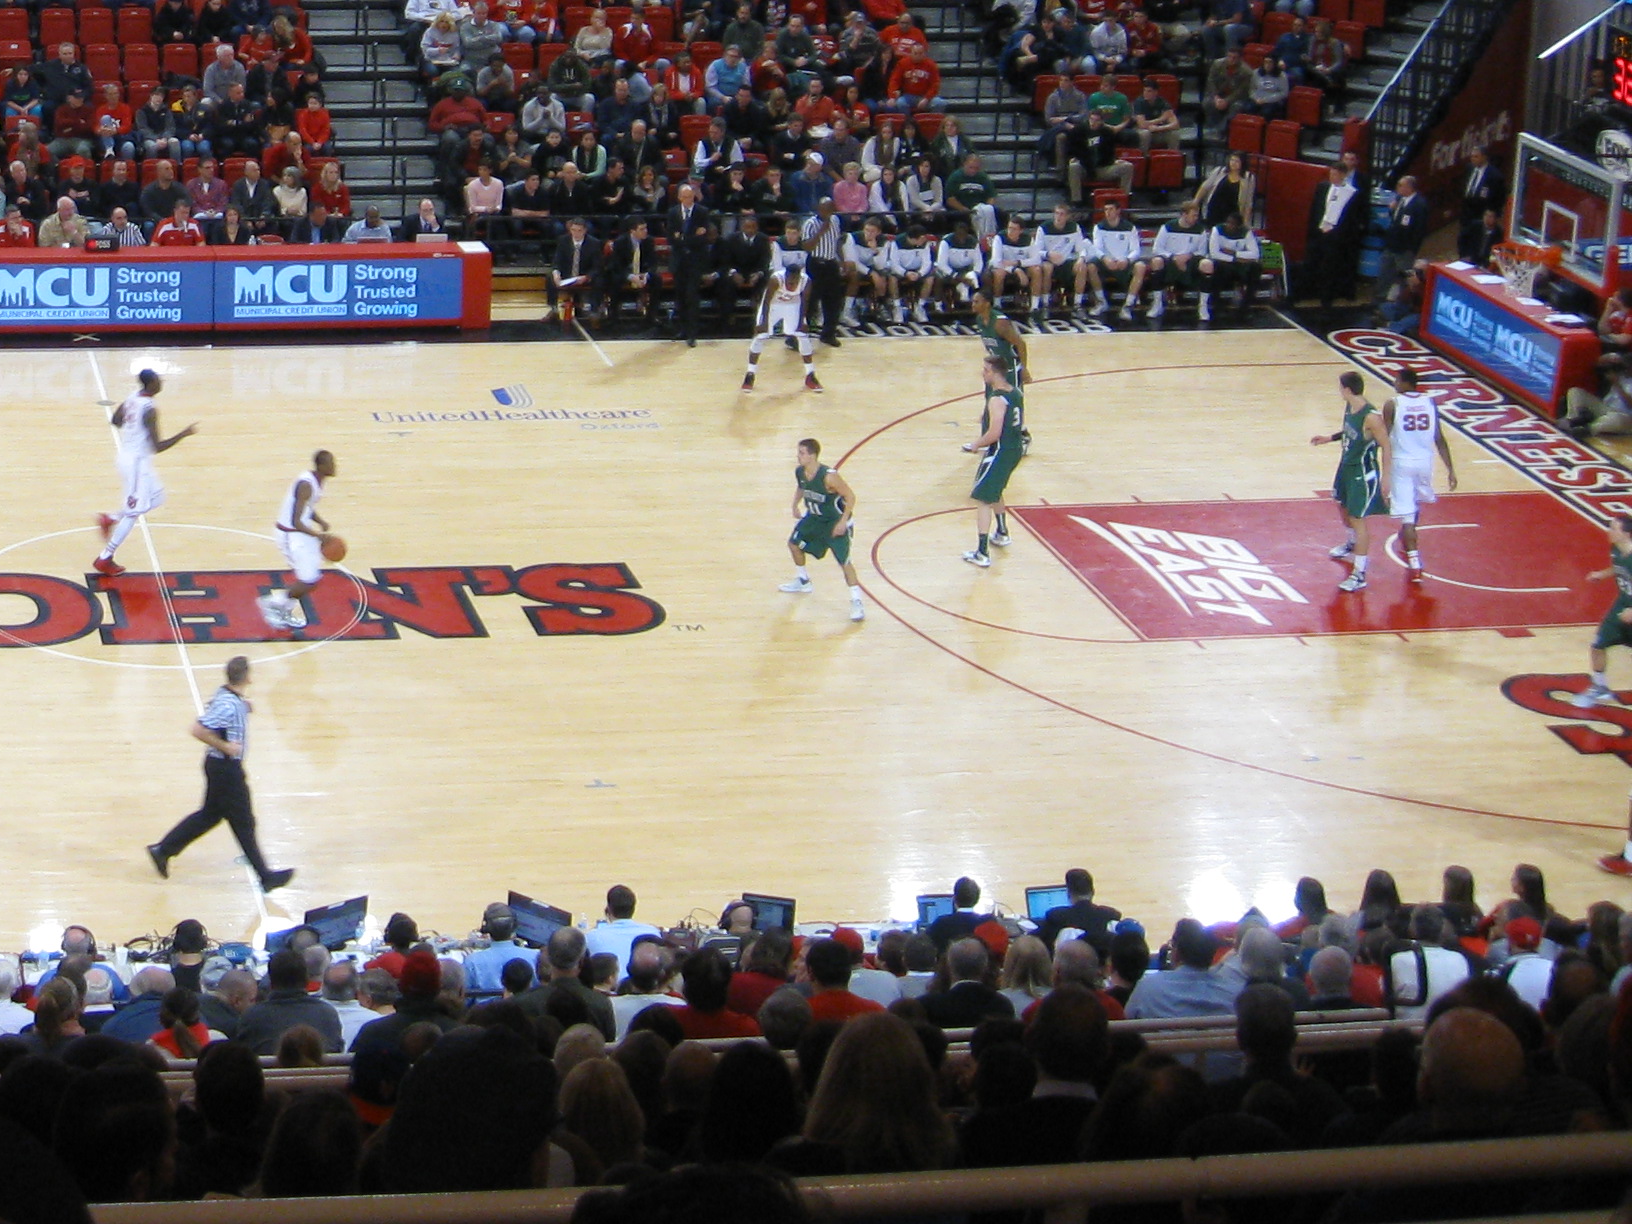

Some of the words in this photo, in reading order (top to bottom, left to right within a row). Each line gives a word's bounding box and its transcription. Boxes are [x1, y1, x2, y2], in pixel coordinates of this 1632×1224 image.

[117, 267, 181, 286] Strong
[354, 264, 418, 282] Strong
[234, 264, 347, 303] MCU
[354, 284, 416, 298] Trusted
[117, 288, 180, 302] Trusted
[46, 309, 76, 318] CREDIT
[79, 309, 108, 317] UNION
[117, 305, 182, 322] Growing
[236, 307, 282, 315] MUNICIPAL
[285, 306, 314, 314] CREDIT
[317, 305, 346, 313] UNION
[354, 301, 418, 317] Growing
[1437, 291, 1474, 329] MCU
[1495, 324, 1534, 364] MCU
[371, 408, 652, 424] UnitedHealthcare
[1403, 413, 1431, 432] 33
[1107, 521, 1273, 626] EAST
[1172, 531, 1310, 604] BIG
